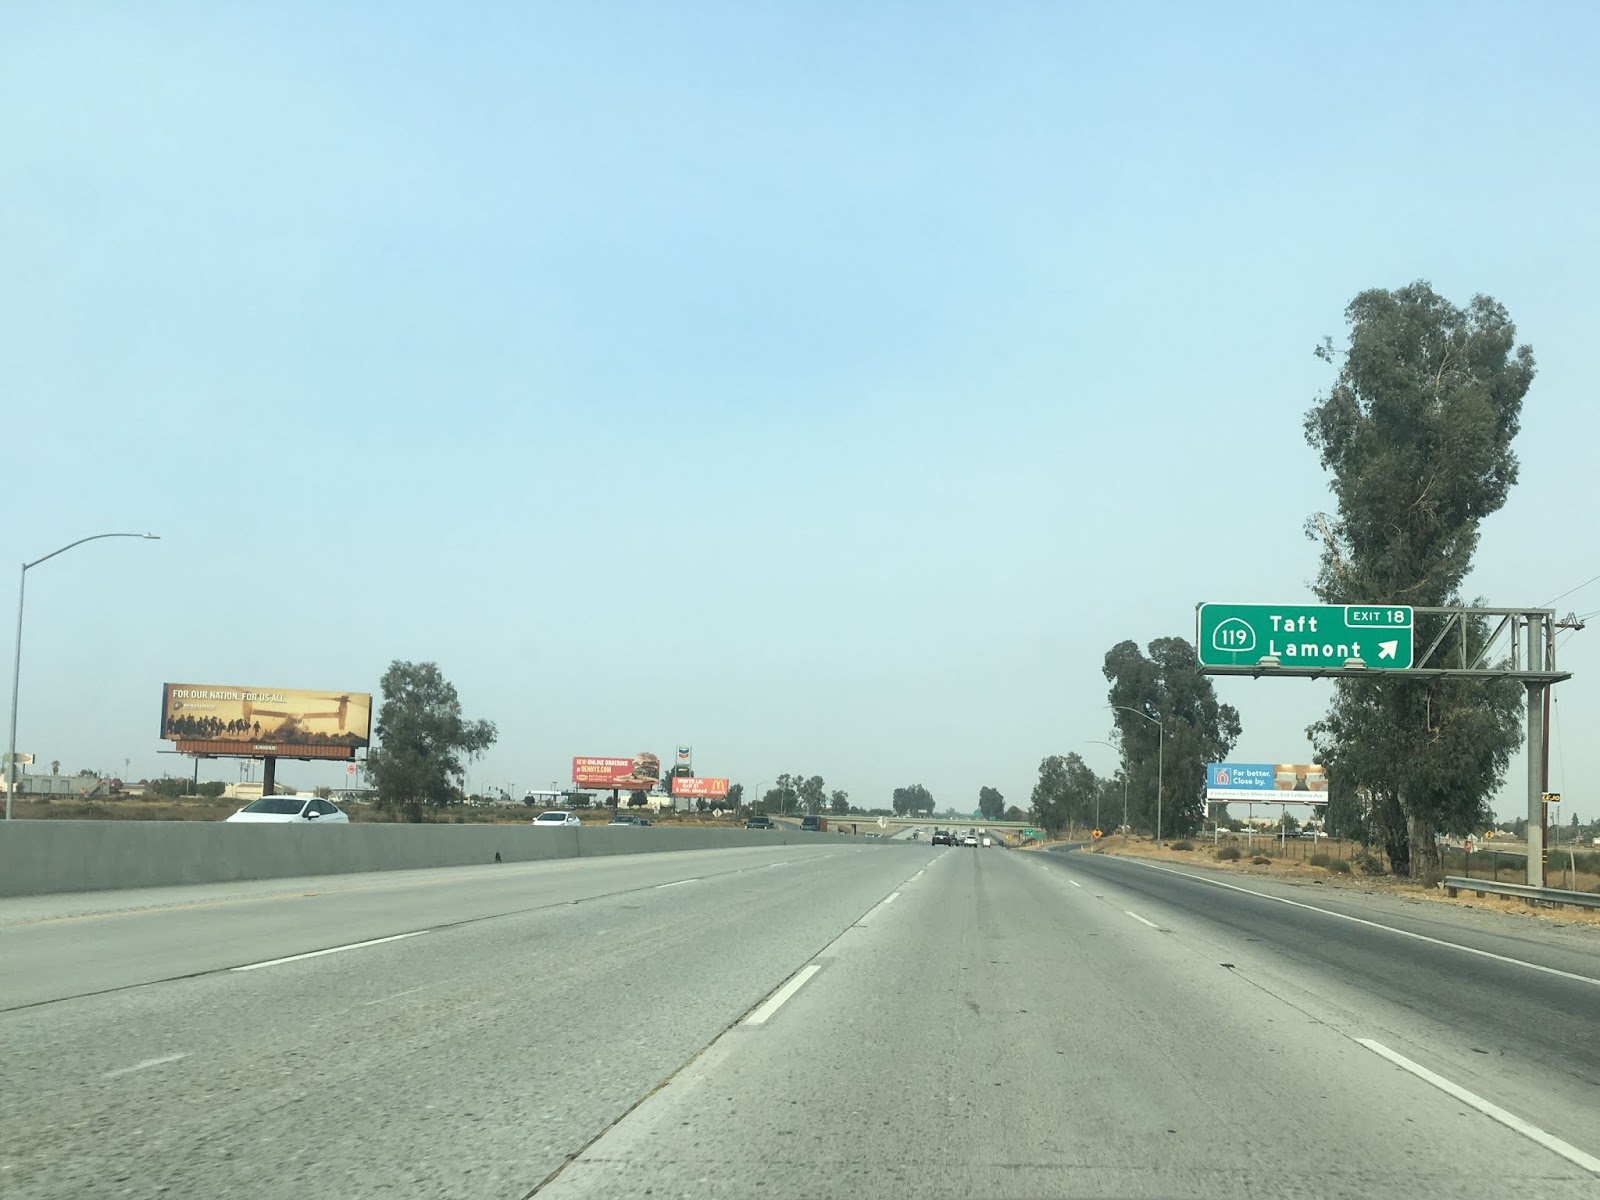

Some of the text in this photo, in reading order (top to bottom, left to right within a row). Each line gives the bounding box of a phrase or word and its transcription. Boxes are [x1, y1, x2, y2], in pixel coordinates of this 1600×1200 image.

[1269, 615, 1318, 633] Taft
[1353, 610, 1405, 624] EXIT 18
[1221, 629, 1247, 645] 119
[1269, 639, 1361, 658] Lamont
[172, 689, 189, 698] FOR
[191, 690, 208, 699] OUR
[209, 691, 240, 700] NATION.
[241, 692, 258, 701] FOR
[259, 693, 270, 701] US
[1246, 769, 1271, 777] better.
[1232, 777, 1266, 786] Close by.
